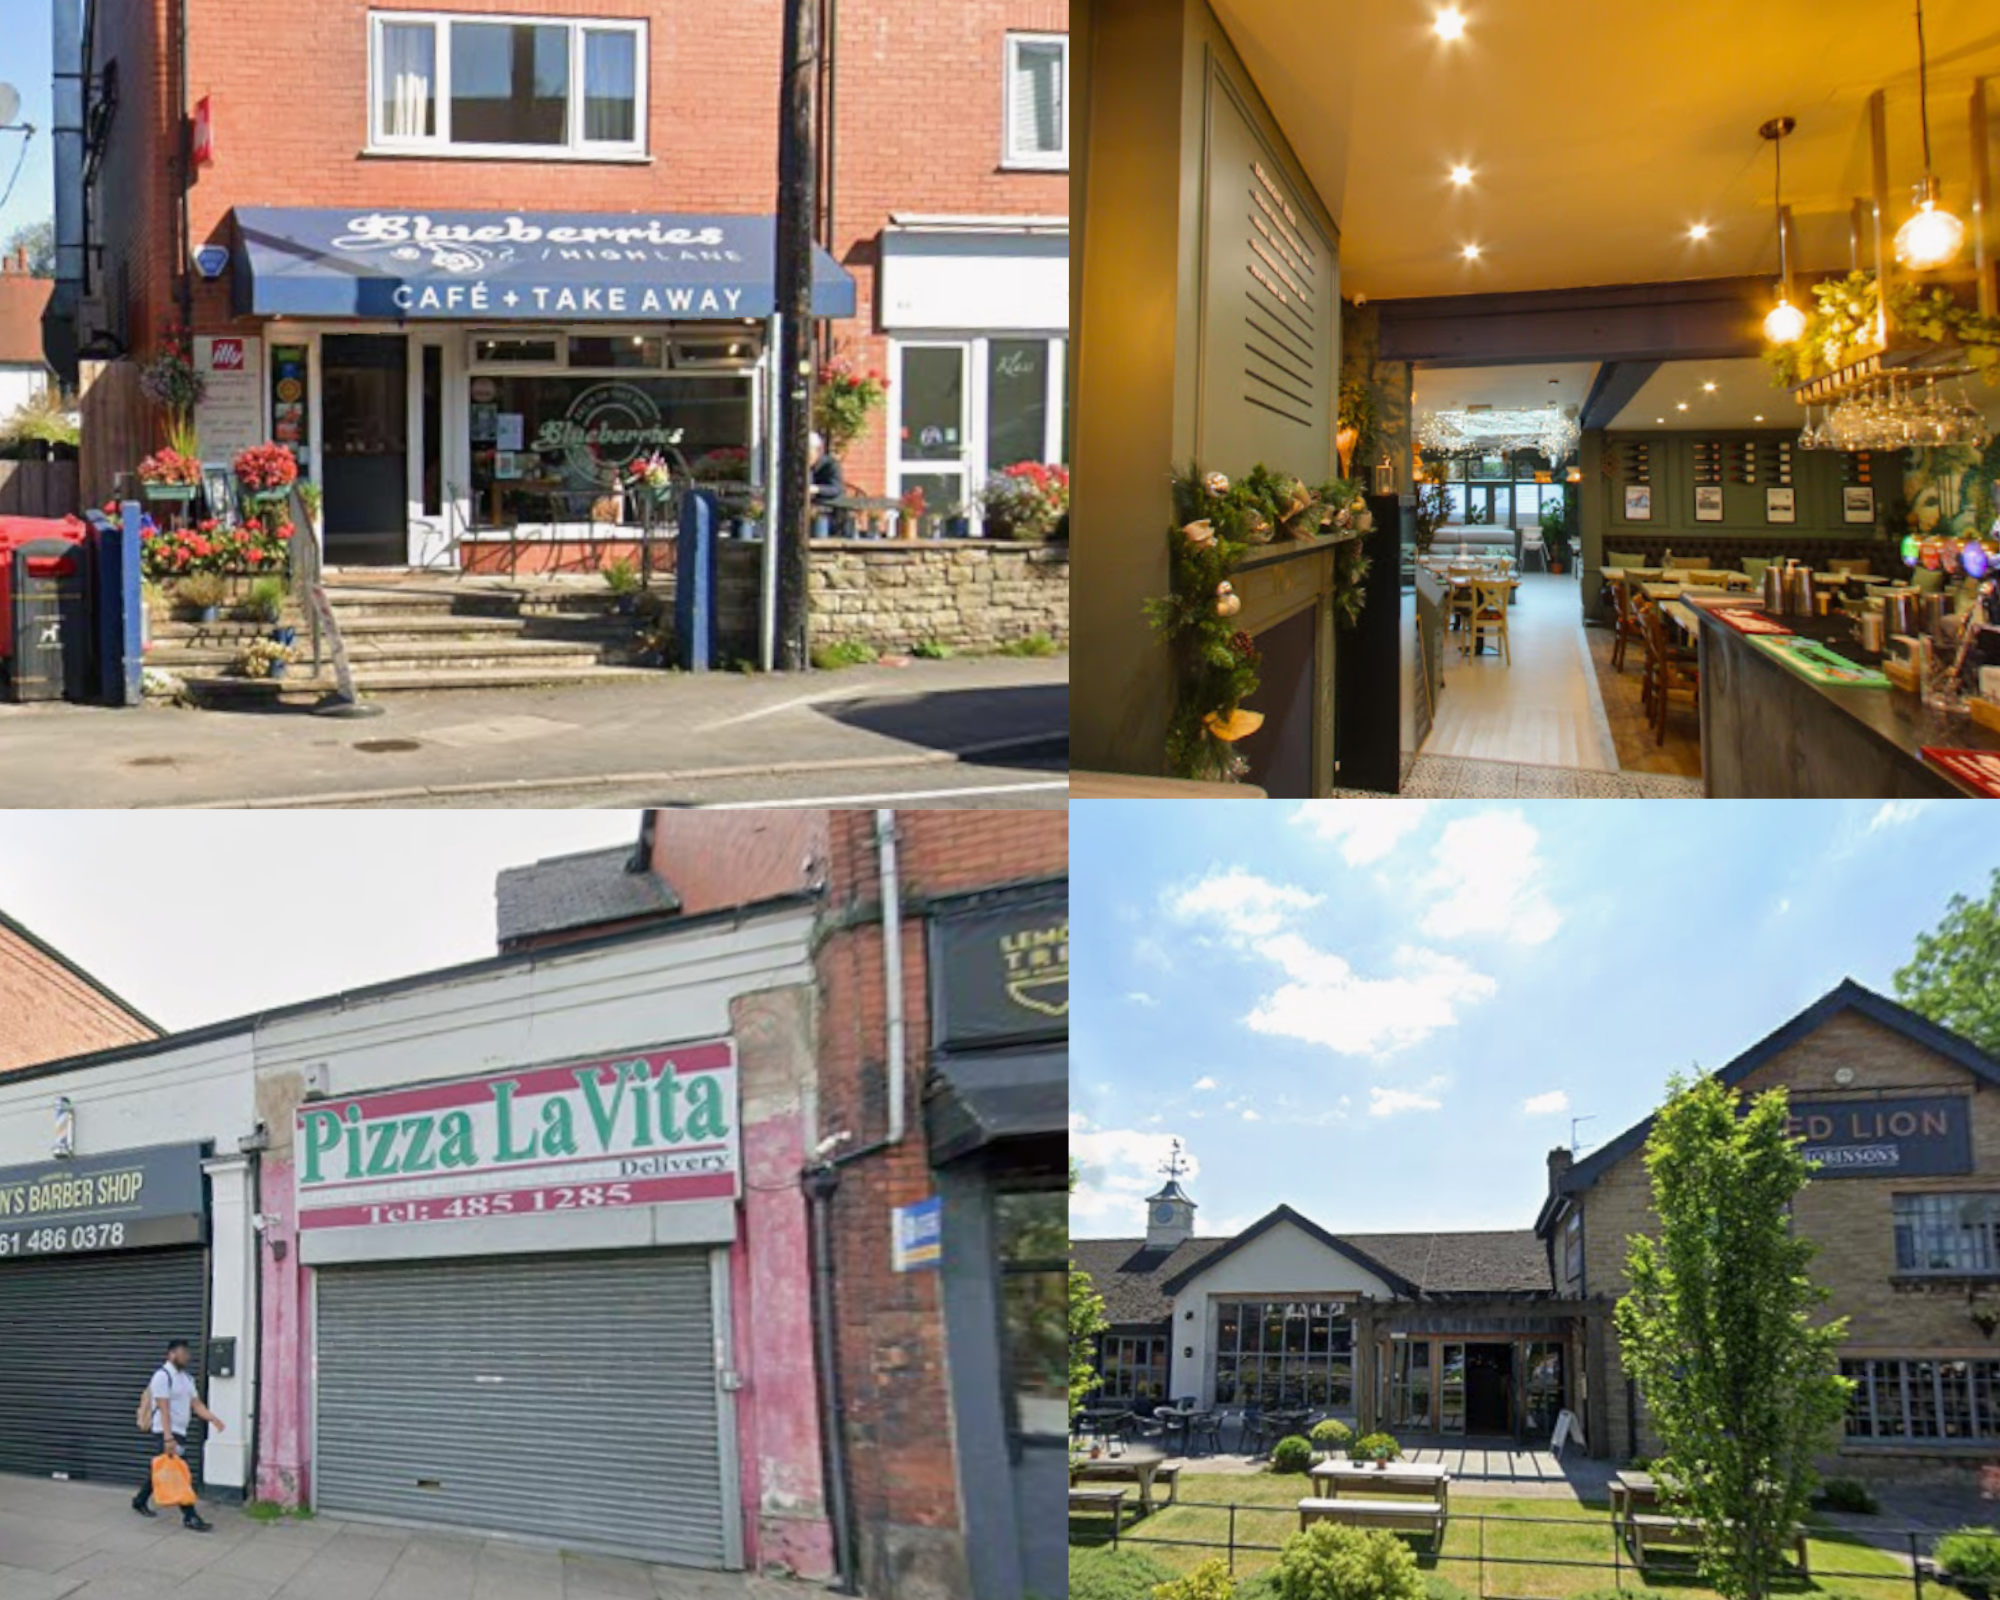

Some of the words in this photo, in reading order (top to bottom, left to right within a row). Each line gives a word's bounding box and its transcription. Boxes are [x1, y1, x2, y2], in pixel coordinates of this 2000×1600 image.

[332, 213, 724, 249] Blueberries
[393, 281, 490, 310] CAFÉ
[532, 288, 627, 310] TAKE
[641, 288, 743, 311] AWAY
[530, 418, 685, 451] Blueberries
[1783, 1115, 1834, 1141] ED
[1852, 1109, 1948, 1139] LION
[301, 1104, 479, 1183] Pizza
[620, 1154, 729, 1177] Delivery
[28, 1178, 94, 1213] BARBER
[97, 1171, 143, 1205] SHOP
[362, 1203, 429, 1224] Tel:
[443, 1194, 515, 1217] 485
[531, 1183, 632, 1212] 1285
[27, 1226, 67, 1251] 486
[71, 1221, 125, 1249] 0378
